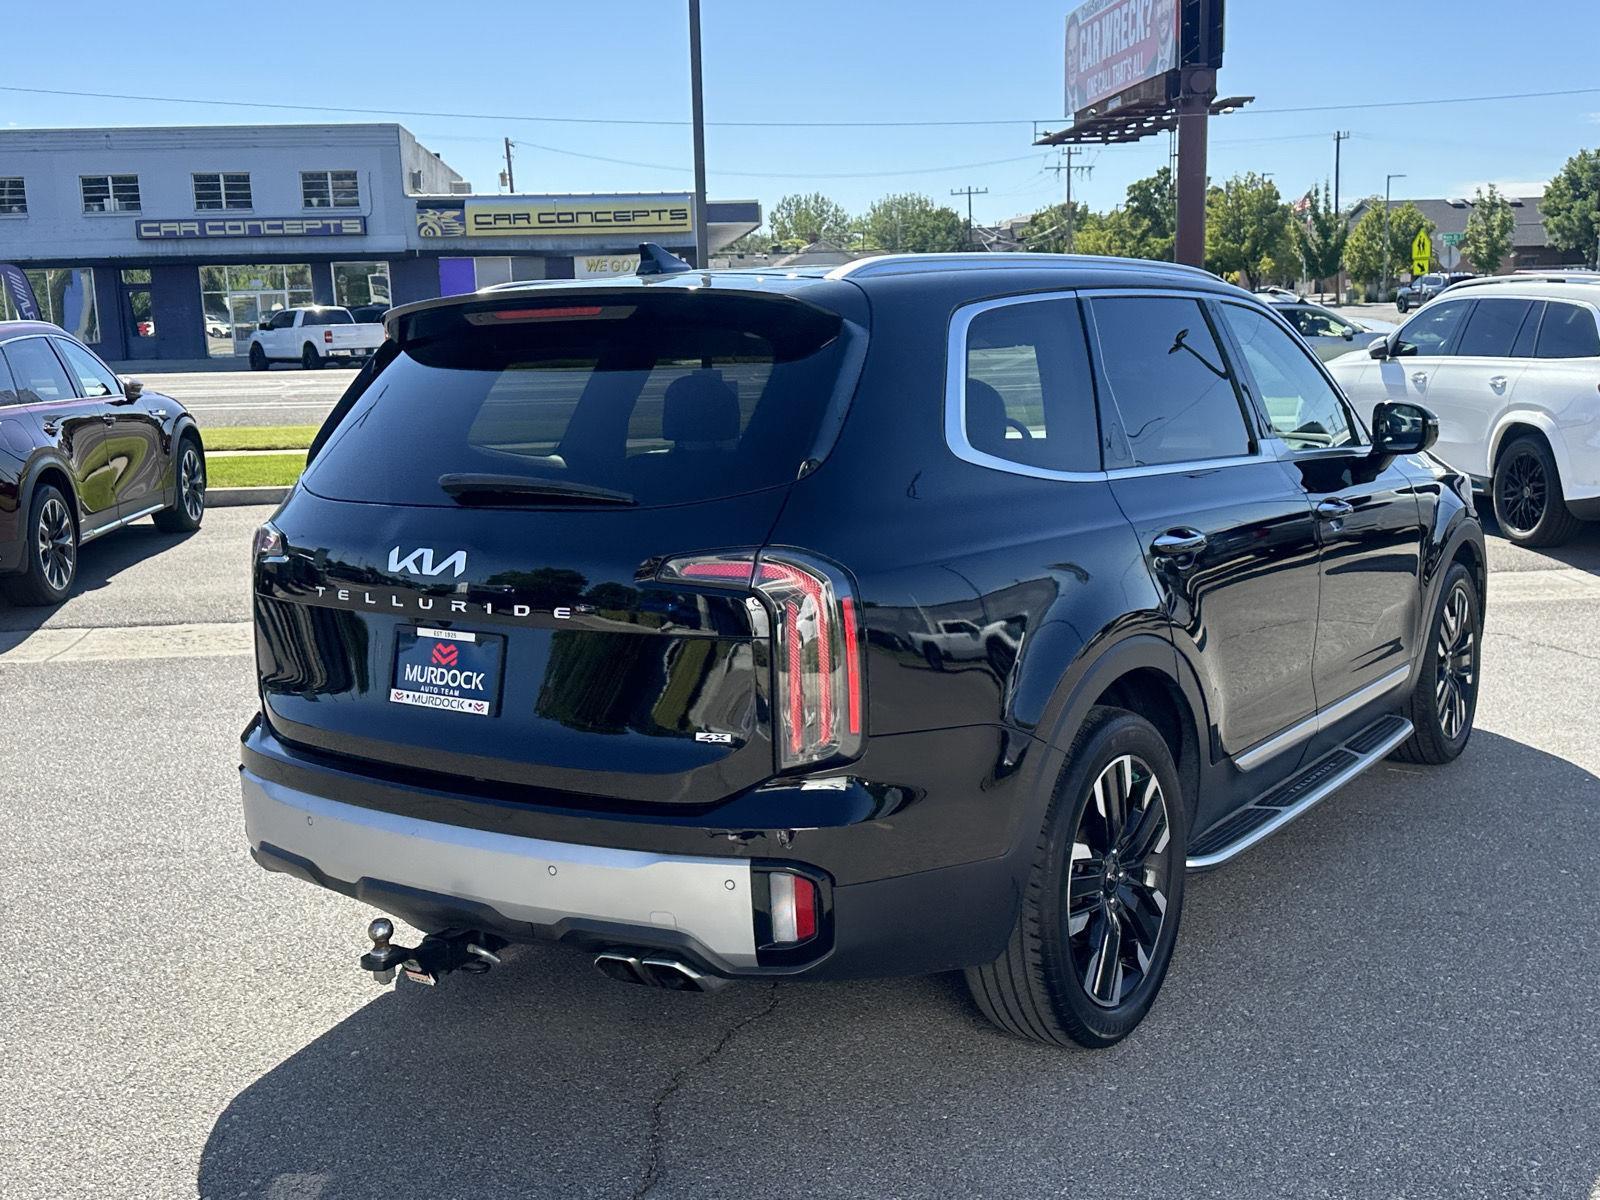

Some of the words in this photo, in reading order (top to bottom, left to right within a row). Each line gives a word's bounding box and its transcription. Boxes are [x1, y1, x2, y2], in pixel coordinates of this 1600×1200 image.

[1080, 20, 1101, 73] CAR
[1101, 0, 1154, 59] WRECK?
[1086, 74, 1099, 100] ONE
[1098, 66, 1112, 95] CALL
[1112, 56, 1133, 88] THAT'S
[1132, 50, 1146, 78] ALL
[474, 212, 532, 226] CAR
[537, 208, 689, 224] CONCEPTS
[140, 222, 200, 237] CAR
[205, 219, 362, 236] CONCEPTS
[585, 258, 608, 273] WE
[611, 258, 640, 273] GOT
[387, 545, 467, 578] KIA
[315, 585, 572, 620] TELLURIDE
[444, 631, 457, 639] 1925
[404, 663, 486, 691] MURDOCK
[420, 685, 439, 694] AUTO
[440, 687, 460, 697] TEAM
[411, 693, 466, 710] MURDOCK
